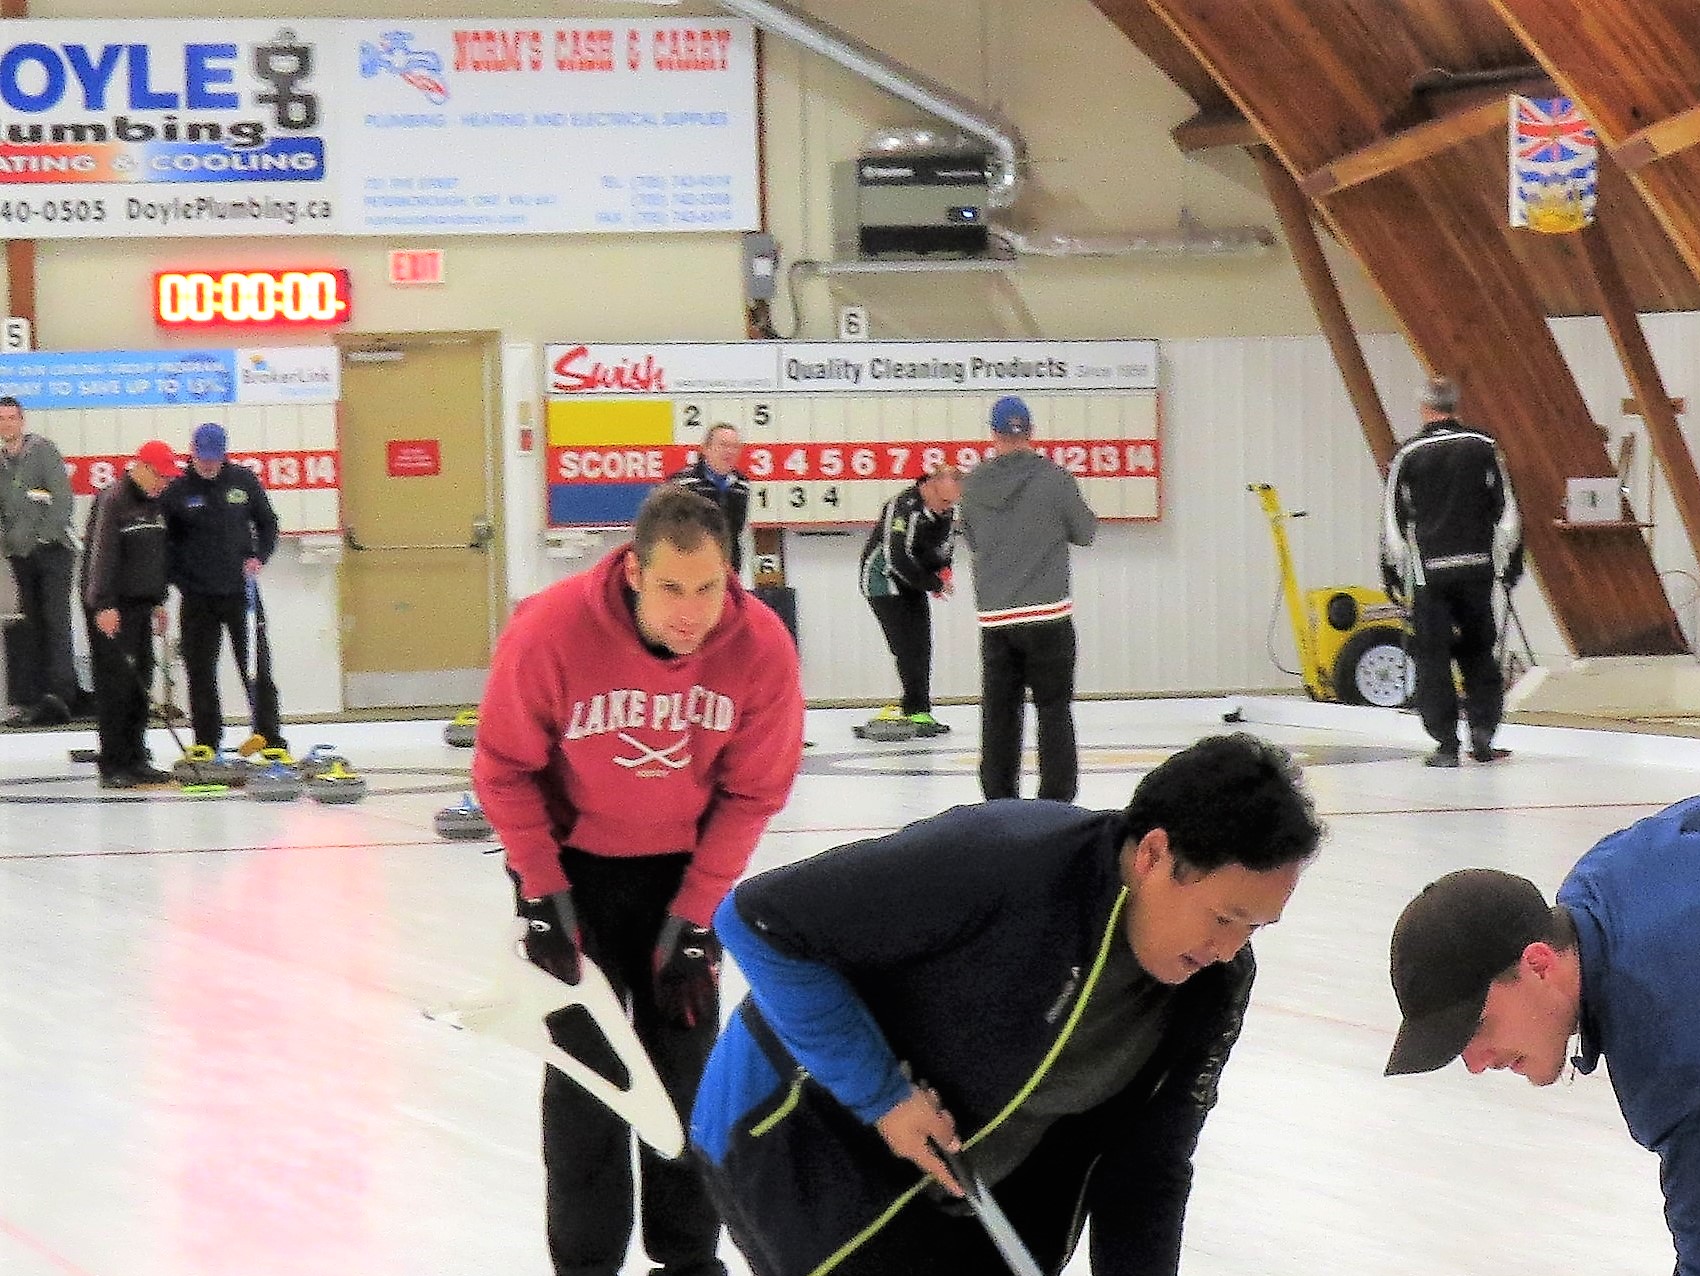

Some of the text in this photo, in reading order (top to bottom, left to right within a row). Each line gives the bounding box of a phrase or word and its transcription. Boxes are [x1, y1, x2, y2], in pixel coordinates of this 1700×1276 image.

[555, 29, 614, 72] CASH
[653, 29, 732, 71] CARRY
[151, 153, 318, 172] COOLING
[126, 197, 333, 225] DoylePlumbing.ca
[7, 324, 22, 347] 5
[845, 310, 861, 334] 6
[786, 357, 861, 385] Quality
[870, 356, 966, 383] Cleaning
[971, 355, 1068, 380] Products
[684, 403, 770, 428] 2 5
[89, 461, 116, 489] 8
[267, 457, 297, 484] 13
[303, 456, 336, 484] 14
[558, 450, 665, 479] SCORE
[748, 448, 775, 477] 3
[783, 448, 809, 476] 4
[819, 448, 845, 476] 5
[851, 448, 878, 476] 6
[886, 447, 912, 475] 7
[921, 447, 947, 475] 8
[1090, 445, 1121, 473] 13
[1126, 444, 1156, 473] 14
[758, 486, 840, 509] 1 3 4
[565, 683, 736, 740] LAKE PLCID
